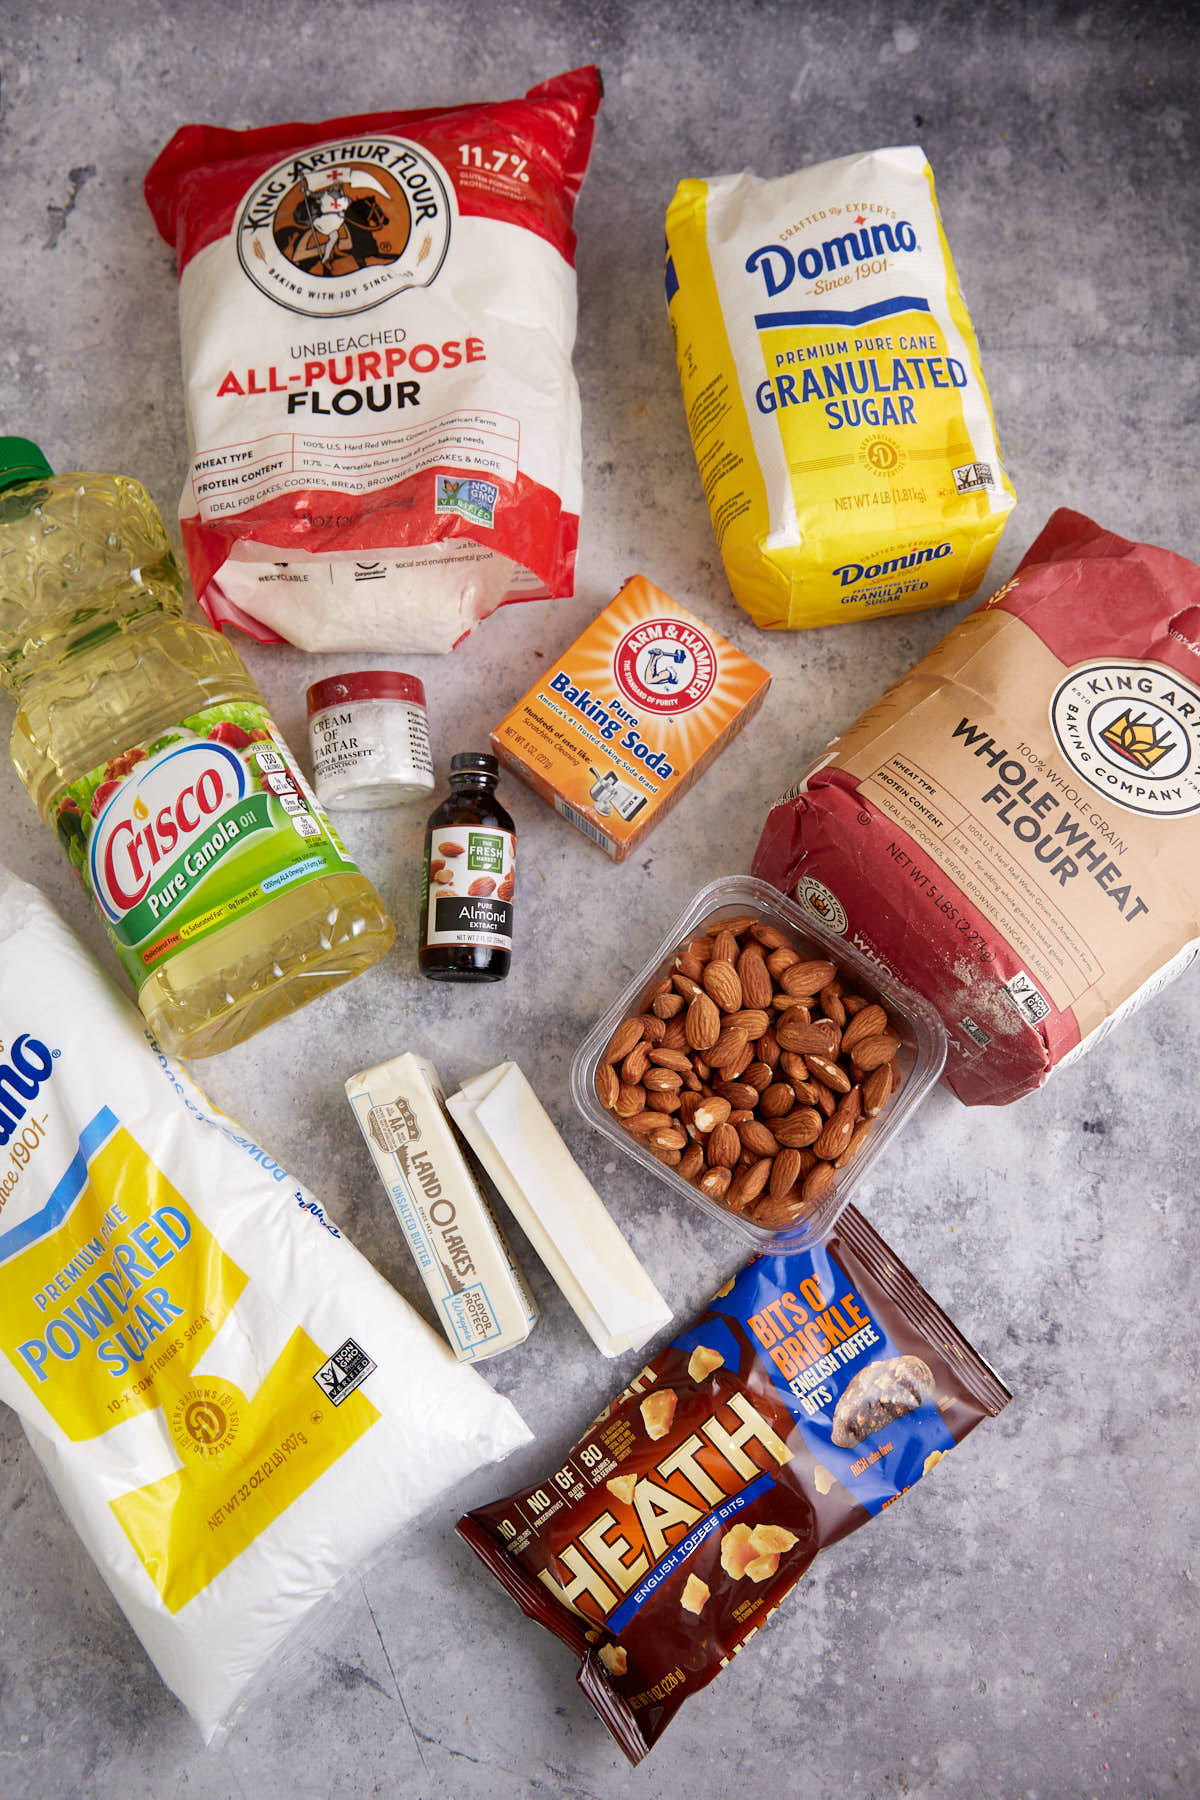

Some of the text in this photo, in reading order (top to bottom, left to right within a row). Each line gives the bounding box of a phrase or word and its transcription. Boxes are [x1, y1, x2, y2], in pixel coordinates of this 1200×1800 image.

[458, 144, 529, 183] 11.7%
[244, 145, 438, 235] KING ARTHUR FLOUR
[779, 202, 897, 241] CRAFTED EXPERTS
[745, 220, 918, 298] Domino
[268, 268, 358, 300] BAKING WITH JOY
[291, 328, 406, 359] UNBLEACHED
[775, 335, 937, 367] PREMIUM PURE CANE
[216, 336, 486, 398] ALL-PURPOSE
[287, 380, 421, 415] FLOUR
[756, 357, 968, 414] GRANULATED
[825, 395, 918, 430] SUGAR
[364, 440, 379, 449] Red
[381, 436, 404, 447] Wheat
[195, 450, 253, 471] WHEAT TYPE
[197, 461, 284, 494] PROTEIN CONTENT
[210, 502, 236, 513] IDEAL
[238, 494, 255, 507] FOR
[284, 477, 329, 488] COOKIES,
[331, 479, 366, 490] BREAD,
[415, 454, 463, 468] PANCAKES
[474, 457, 501, 470] MORE
[471, 482, 496, 496] NON
[470, 490, 496, 504] GMO
[834, 492, 891, 512] NET WT 4 LB
[832, 543, 951, 586] Domino
[841, 581, 929, 604] GRANULATED
[627, 625, 711, 699] ARM & HAMMER
[1087, 676, 1153, 695] KING
[313, 713, 352, 735] CREAM
[550, 672, 674, 780] Baking Soda
[608, 699, 639, 729] Pure
[314, 738, 359, 760] TARTAR
[323, 729, 338, 742] OF
[524, 706, 593, 766] Hundreds uses like:
[537, 693, 659, 794] America's Trusted Baking Soda Brand
[1066, 703, 1182, 801] BAKING COMPANY
[261, 753, 277, 764] 130
[892, 759, 937, 796] WHEAT TYPE
[877, 771, 944, 829] PROTEIN CONTENT
[1016, 742, 1128, 857] 100% WHOLE GRAIN
[951, 717, 1150, 923] WHOLE WHEAT
[967, 823, 985, 842] 100%
[981, 783, 1079, 888] FLOUR
[104, 768, 224, 910] Crisco
[469, 845, 503, 858] FRESH
[147, 810, 258, 919] Pure Canola Oil
[882, 798, 902, 818] IDEAL
[901, 816, 917, 832] FOR
[915, 828, 944, 858] COOKIES,
[943, 857, 966, 883] BREAD,
[966, 880, 1000, 918] BROWNIES,
[885, 842, 912, 869] NET
[909, 866, 931, 888] WT
[926, 885, 939, 898] 5
[934, 894, 959, 921] LBS
[188, 913, 214, 932] Saturated
[459, 906, 506, 924] Almond
[469, 921, 498, 930] EXTRACT
[1027, 998, 1044, 1017] GMO
[1033, 993, 1048, 1012] NON
[390, 1117, 405, 1132] AA
[391, 1184, 432, 1268] UNSALTED BUTTER
[411, 1151, 474, 1277] LAND O LAKES
[32, 1236, 106, 1313] PREMIUM
[462, 1292, 486, 1337] PROTECT
[472, 1293, 492, 1330] FLAVOR
[746, 1292, 809, 1350] BITS
[334, 1344, 354, 1363] NON
[767, 1292, 871, 1382] BRICKLE
[339, 1349, 359, 1368] GMO
[788, 1325, 880, 1398] ENGLISH TOFFEE
[329, 1359, 370, 1397] VERIFIED
[800, 1386, 833, 1416] BITS
[580, 1444, 603, 1468] 80
[599, 1460, 618, 1479] SERVING
[849, 1456, 869, 1478] RICH
[207, 1431, 308, 1532] NET WT 32 OZ (2 LB) 907g
[554, 1466, 575, 1490] GF
[567, 1483, 584, 1499] GLUTEN
[526, 1490, 551, 1515] NO
[537, 1391, 796, 1622] HEATH
[574, 1490, 586, 1502] FREE
[497, 1519, 517, 1541] NO
[534, 1500, 564, 1528] PRESERVATIVES
[633, 1554, 679, 1604] ENGLISH
[719, 1497, 745, 1519] BITS
[662, 1673, 679, 1695] (226
